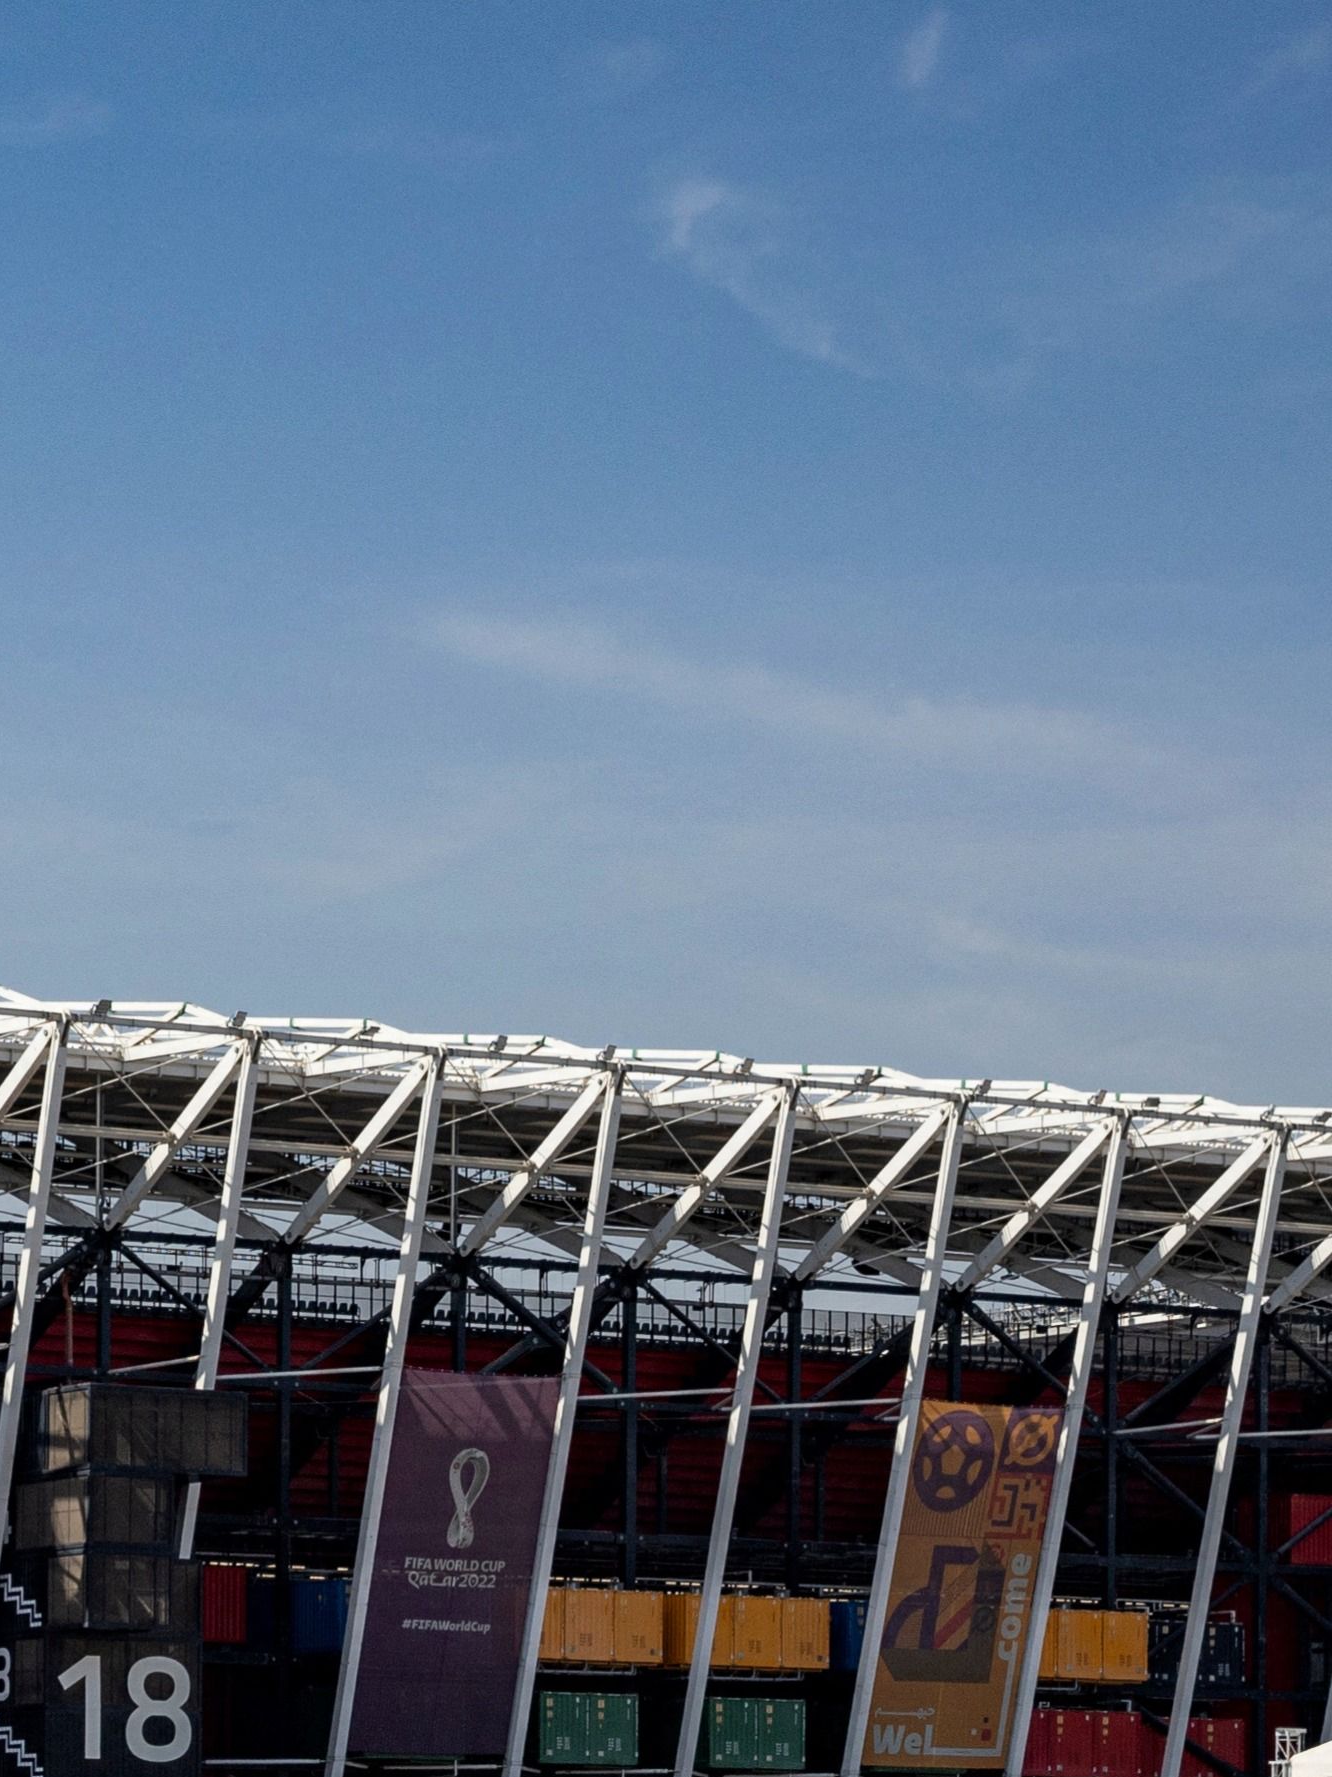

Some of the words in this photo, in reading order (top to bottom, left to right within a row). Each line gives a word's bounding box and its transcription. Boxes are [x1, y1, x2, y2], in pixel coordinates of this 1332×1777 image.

[404, 1556, 432, 1570] FIFA
[433, 1558, 479, 1572] WORLD
[481, 1560, 506, 1573] CUP
[401, 1618, 491, 1635] #FIFAWorldCup
[57, 1655, 193, 1763] 18
